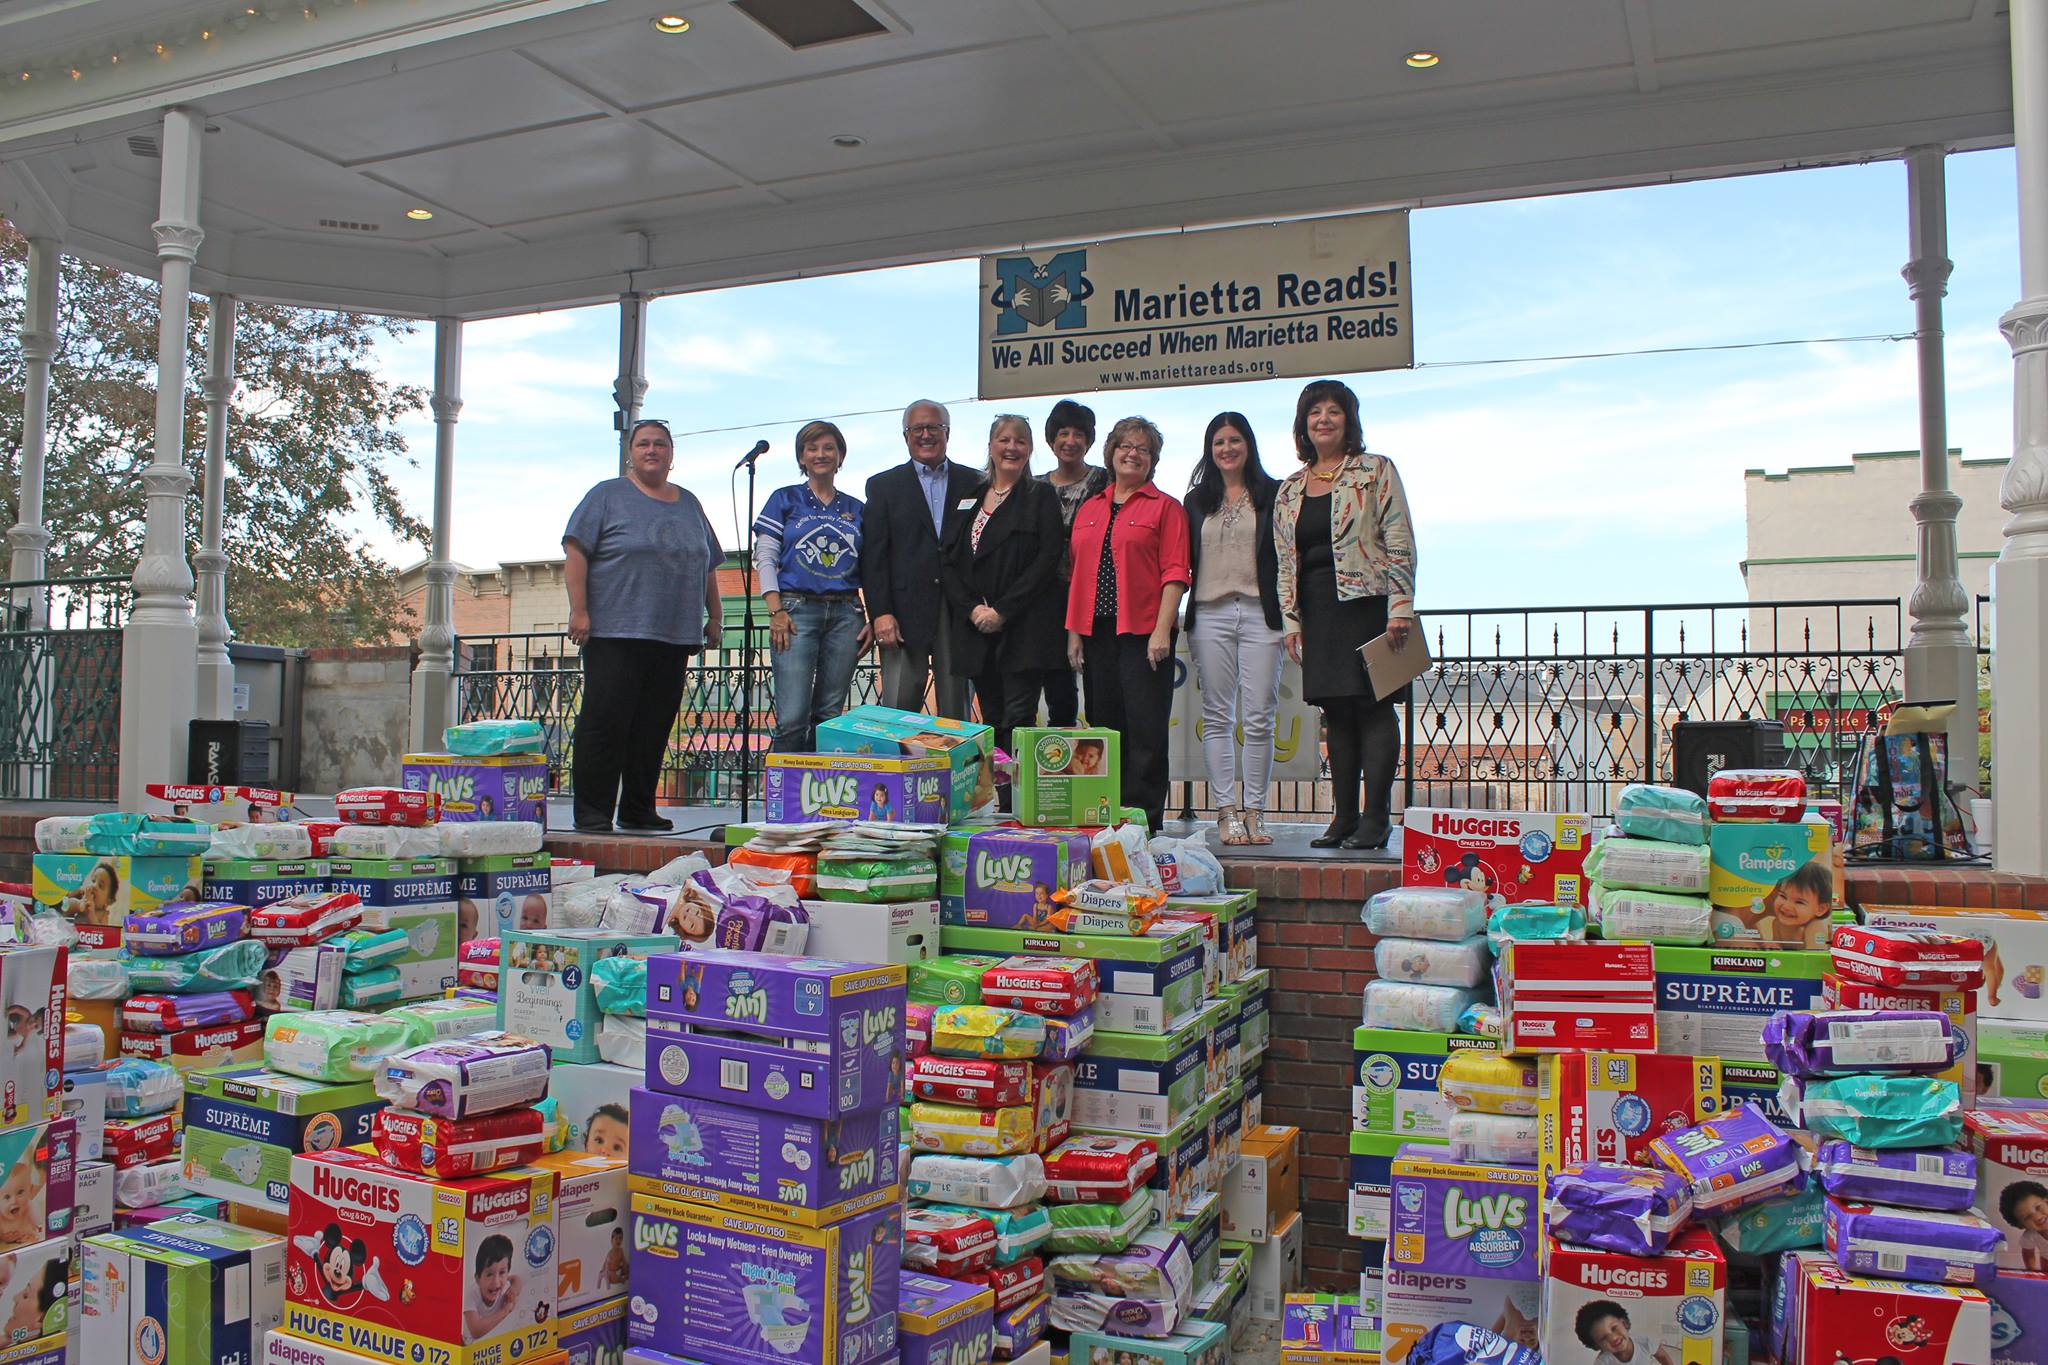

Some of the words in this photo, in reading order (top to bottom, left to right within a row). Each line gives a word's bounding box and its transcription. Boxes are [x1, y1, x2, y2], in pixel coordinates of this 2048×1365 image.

[1113, 279, 1261, 322] Marietta
[1277, 261, 1398, 309] Reads!
[992, 346, 1021, 369] We
[1028, 341, 1054, 366] All
[1062, 334, 1151, 364] Succeed
[1160, 331, 1217, 356] When
[1226, 319, 1318, 349] Marietta
[1327, 313, 1398, 342] Reads
[1099, 359, 1275, 384] www.mariettareads.org
[164, 785, 204, 799] HUGGIES
[250, 788, 278, 801] HUGGIES
[519, 776, 544, 800] Luvs
[802, 770, 858, 815] Luvs
[917, 777, 938, 802] Luvs
[339, 794, 368, 803] HUGGIES
[1432, 813, 1520, 837] HUGGIES
[1563, 829, 1577, 838] 12
[278, 864, 304, 872] KIRKLAND
[412, 864, 436, 872] KIRKLAND
[513, 857, 533, 866] KIRKLAND
[1739, 852, 1795, 872] Pampers
[976, 851, 1032, 890] Luvs
[394, 879, 452, 898] SUPRÊME
[496, 870, 549, 891] SUPRÊME
[1717, 885, 1762, 894] swaddlers
[1081, 893, 1121, 909] Diapers
[891, 907, 914, 920] diapers
[207, 921, 227, 937] Luvs
[1082, 914, 1125, 931] Diapers
[1721, 924, 1730, 933] 5
[1025, 938, 1059, 948] KIRKLAND
[1713, 956, 1764, 968] KIRKLAND
[1918, 952, 1946, 960] HUGGIES
[567, 971, 576, 984] 4
[1850, 961, 1883, 981] HUGGIES
[806, 984, 821, 994] 100
[843, 982, 859, 992] SAVE
[860, 980, 868, 989] UP
[868, 979, 874, 988] TO
[997, 976, 1041, 989] HUGGIES
[516, 991, 563, 1011] Beginnings
[1666, 982, 1794, 1006] SUPRÊME
[1859, 993, 1931, 1010] HUGGIES
[726, 989, 768, 1024] Luvs
[808, 1001, 815, 1011] 4
[49, 984, 65, 1059] HUGGIES
[863, 1006, 895, 1046] Luvs
[122, 1037, 155, 1051] HUGGIES
[195, 1031, 238, 1048] HUGGIES
[1450, 1039, 1496, 1049] KIRKLAND
[919, 1062, 964, 1077] HUGGIES
[1608, 1060, 1620, 1081] 12
[1620, 1060, 1628, 1083] HOUR
[1725, 1066, 1777, 1080] KIRKLAND
[1700, 1065, 1712, 1092] 152
[224, 1083, 257, 1098] KIRKLAND
[840, 1096, 853, 1108] 100
[206, 1108, 271, 1137] SUPRÊME
[381, 1116, 417, 1135] HUGGIES
[1402, 1110, 1415, 1129] 5
[134, 1123, 169, 1140] HUGGIES
[1517, 1131, 1527, 1140] 27
[51, 1164, 71, 1175] BEST
[79, 1171, 101, 1181] VALUE
[840, 1149, 875, 1189] Luvs
[1248, 1168, 1256, 1178] 4
[1413, 1165, 1432, 1175] Money
[1433, 1167, 1446, 1175] Back
[1487, 1171, 1508, 1180] SAVE
[1509, 1173, 1520, 1181] UP
[1521, 1174, 1533, 1182] TO
[1740, 1159, 1762, 1178] Luvs
[79, 1179, 97, 1189] PACK
[268, 1183, 288, 1199] 180
[314, 1166, 400, 1212] HUGGIES
[559, 1181, 600, 1200] diapers
[680, 1186, 689, 1195] TO
[690, 1187, 700, 1197] UP
[1358, 1185, 1391, 1193] KIRKLAND
[472, 1188, 527, 1214] HUGGIES
[701, 1190, 720, 1201] SAVE
[778, 1184, 807, 1206] Luvs
[339, 1208, 354, 1220] Snug
[359, 1213, 373, 1224] Dry
[654, 1204, 672, 1216] Money
[672, 1208, 685, 1217] Back
[1444, 1186, 1527, 1239] Luvs
[51, 1220, 63, 1229] 128
[75, 1214, 99, 1224] Diapers
[442, 1217, 458, 1234] 12
[723, 1217, 743, 1230] SAVE
[743, 1221, 754, 1231] UP
[755, 1223, 765, 1233] TO
[1354, 1217, 1365, 1231] 5
[439, 1231, 458, 1242] HOUR
[634, 1215, 678, 1251] Luvs
[955, 1232, 983, 1250] HUGGIES
[1403, 1236, 1409, 1245] 5
[1480, 1230, 1508, 1242] SUPER
[687, 1229, 707, 1244] Locks
[707, 1232, 725, 1251] Away
[727, 1235, 756, 1253] Wetness
[761, 1244, 777, 1257] Even
[778, 1247, 813, 1267] Overnight
[1398, 1249, 1411, 1260] 88
[1469, 1240, 1520, 1253] ABSORBENT
[741, 1262, 764, 1281] Night
[775, 1271, 796, 1286] Lock
[1387, 1271, 1467, 1291] diapers
[1581, 1263, 1668, 1289] HUGGIES
[1694, 1270, 1709, 1280] 12
[845, 1251, 872, 1324] Luvs
[53, 1304, 65, 1322] 3
[1365, 1299, 1375, 1313] 5
[572, 1316, 590, 1329] SAVE
[937, 1315, 949, 1328] SAVE
[13, 1328, 27, 1341] 96
[290, 1311, 343, 1342] HUGE
[349, 1325, 405, 1359] VALUE
[415, 1344, 421, 1353] 4
[429, 1348, 450, 1365] 172
[527, 1330, 547, 1348] 172
[269, 1338, 325, 1365] diapers
[473, 1344, 502, 1361] HUGE
